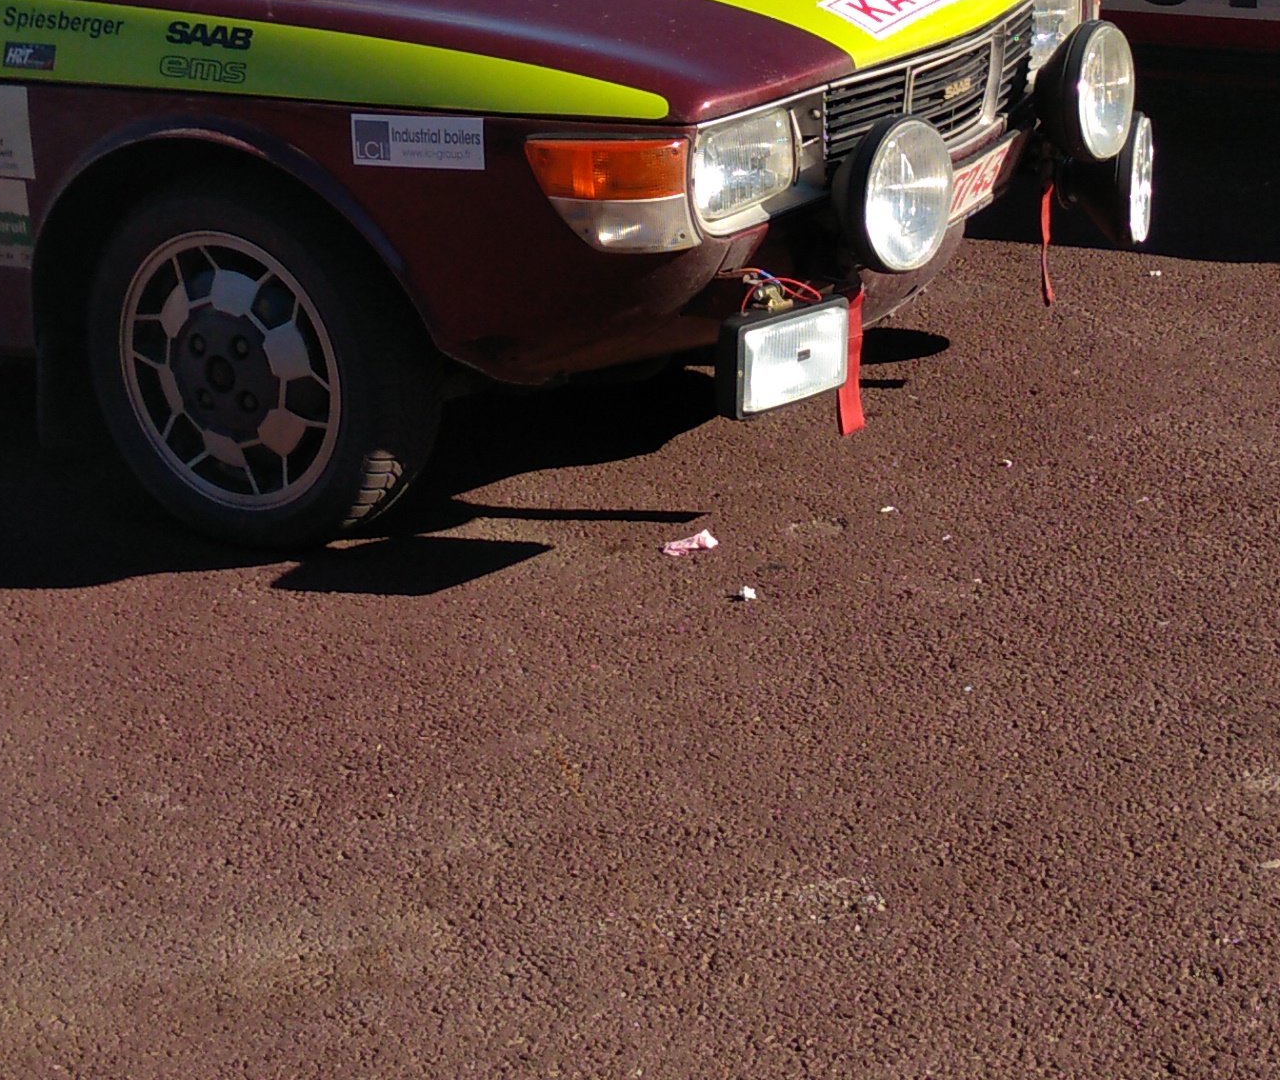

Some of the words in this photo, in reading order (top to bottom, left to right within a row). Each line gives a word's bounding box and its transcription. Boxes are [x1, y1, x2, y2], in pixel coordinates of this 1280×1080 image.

[3, 6, 125, 38] Spiesberger
[165, 21, 254, 50] SAAB
[159, 55, 247, 83] ems
[356, 139, 385, 159] LCI
[444, 128, 481, 146] boilers
